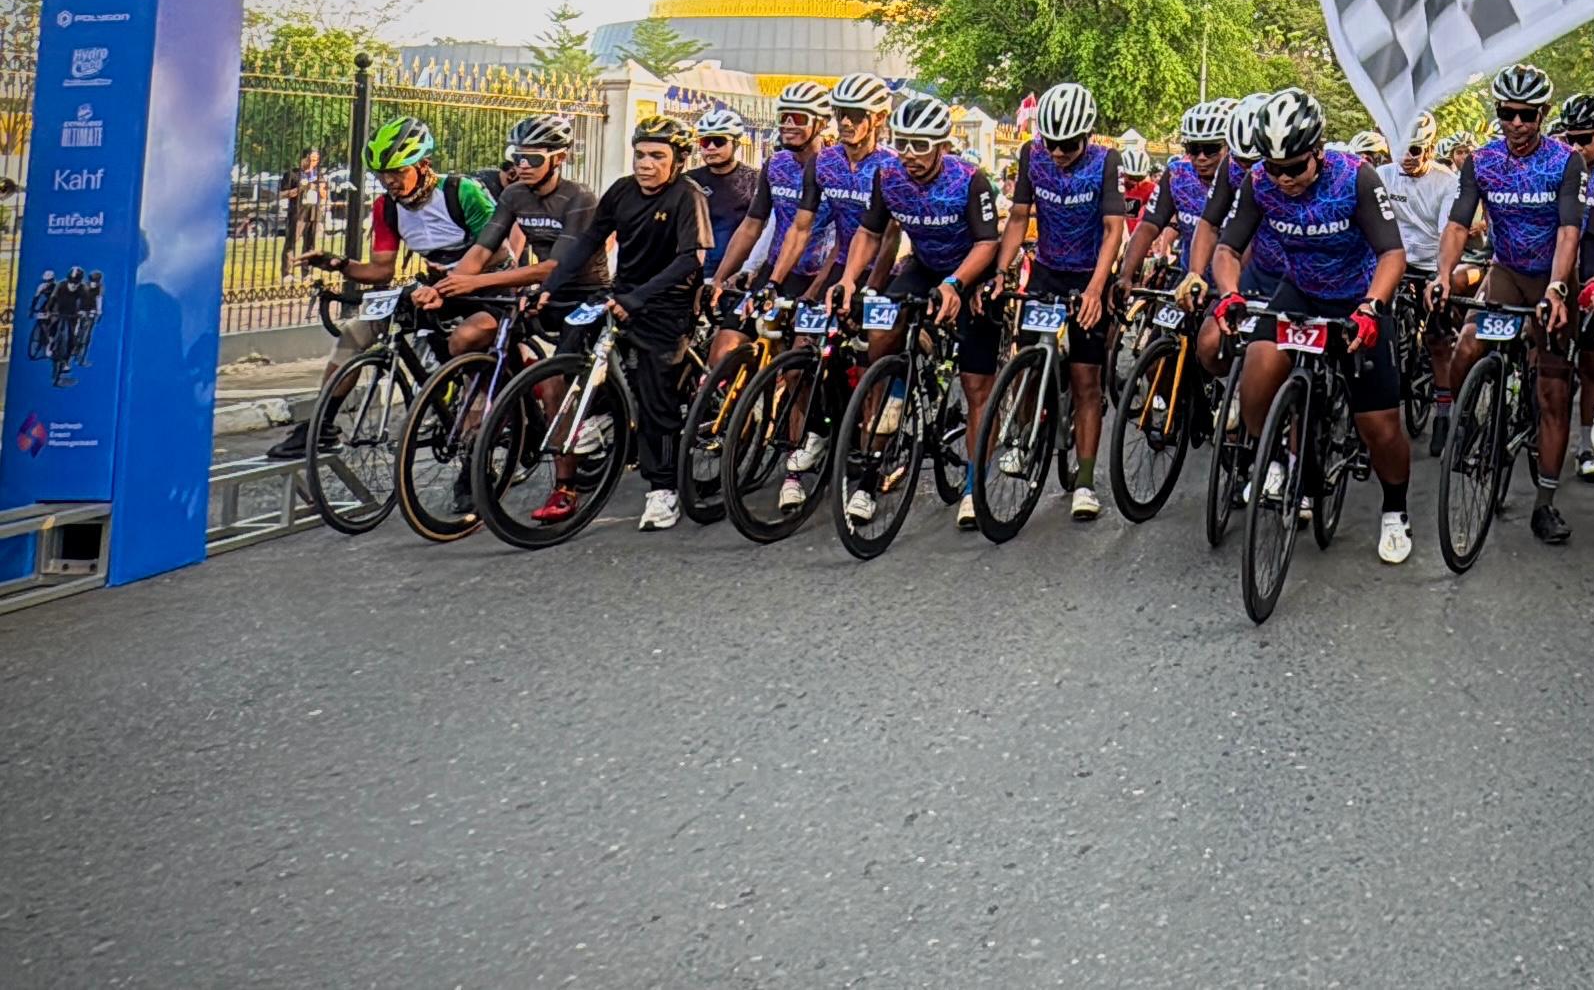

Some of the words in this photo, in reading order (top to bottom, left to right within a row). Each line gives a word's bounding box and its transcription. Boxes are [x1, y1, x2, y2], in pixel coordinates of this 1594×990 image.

[54, 169, 104, 191] Kahf
[771, 186, 798, 198] KOTA
[824, 187, 849, 199] KOTA
[1035, 186, 1062, 204] KOTA
[1064, 191, 1094, 205] BARU
[1487, 191, 1519, 204] KOTA
[1521, 191, 1557, 204] BARU
[48, 211, 104, 226] Entrasol
[891, 211, 919, 226] KOTA
[923, 214, 959, 226] BARU
[1269, 218, 1304, 235] KOTA
[1306, 218, 1350, 236] BARU
[870, 309, 897, 325] 540
[1028, 310, 1061, 328] 522
[1158, 308, 1185, 326] 607
[1482, 318, 1516, 336] 586
[1286, 328, 1320, 346] 167
